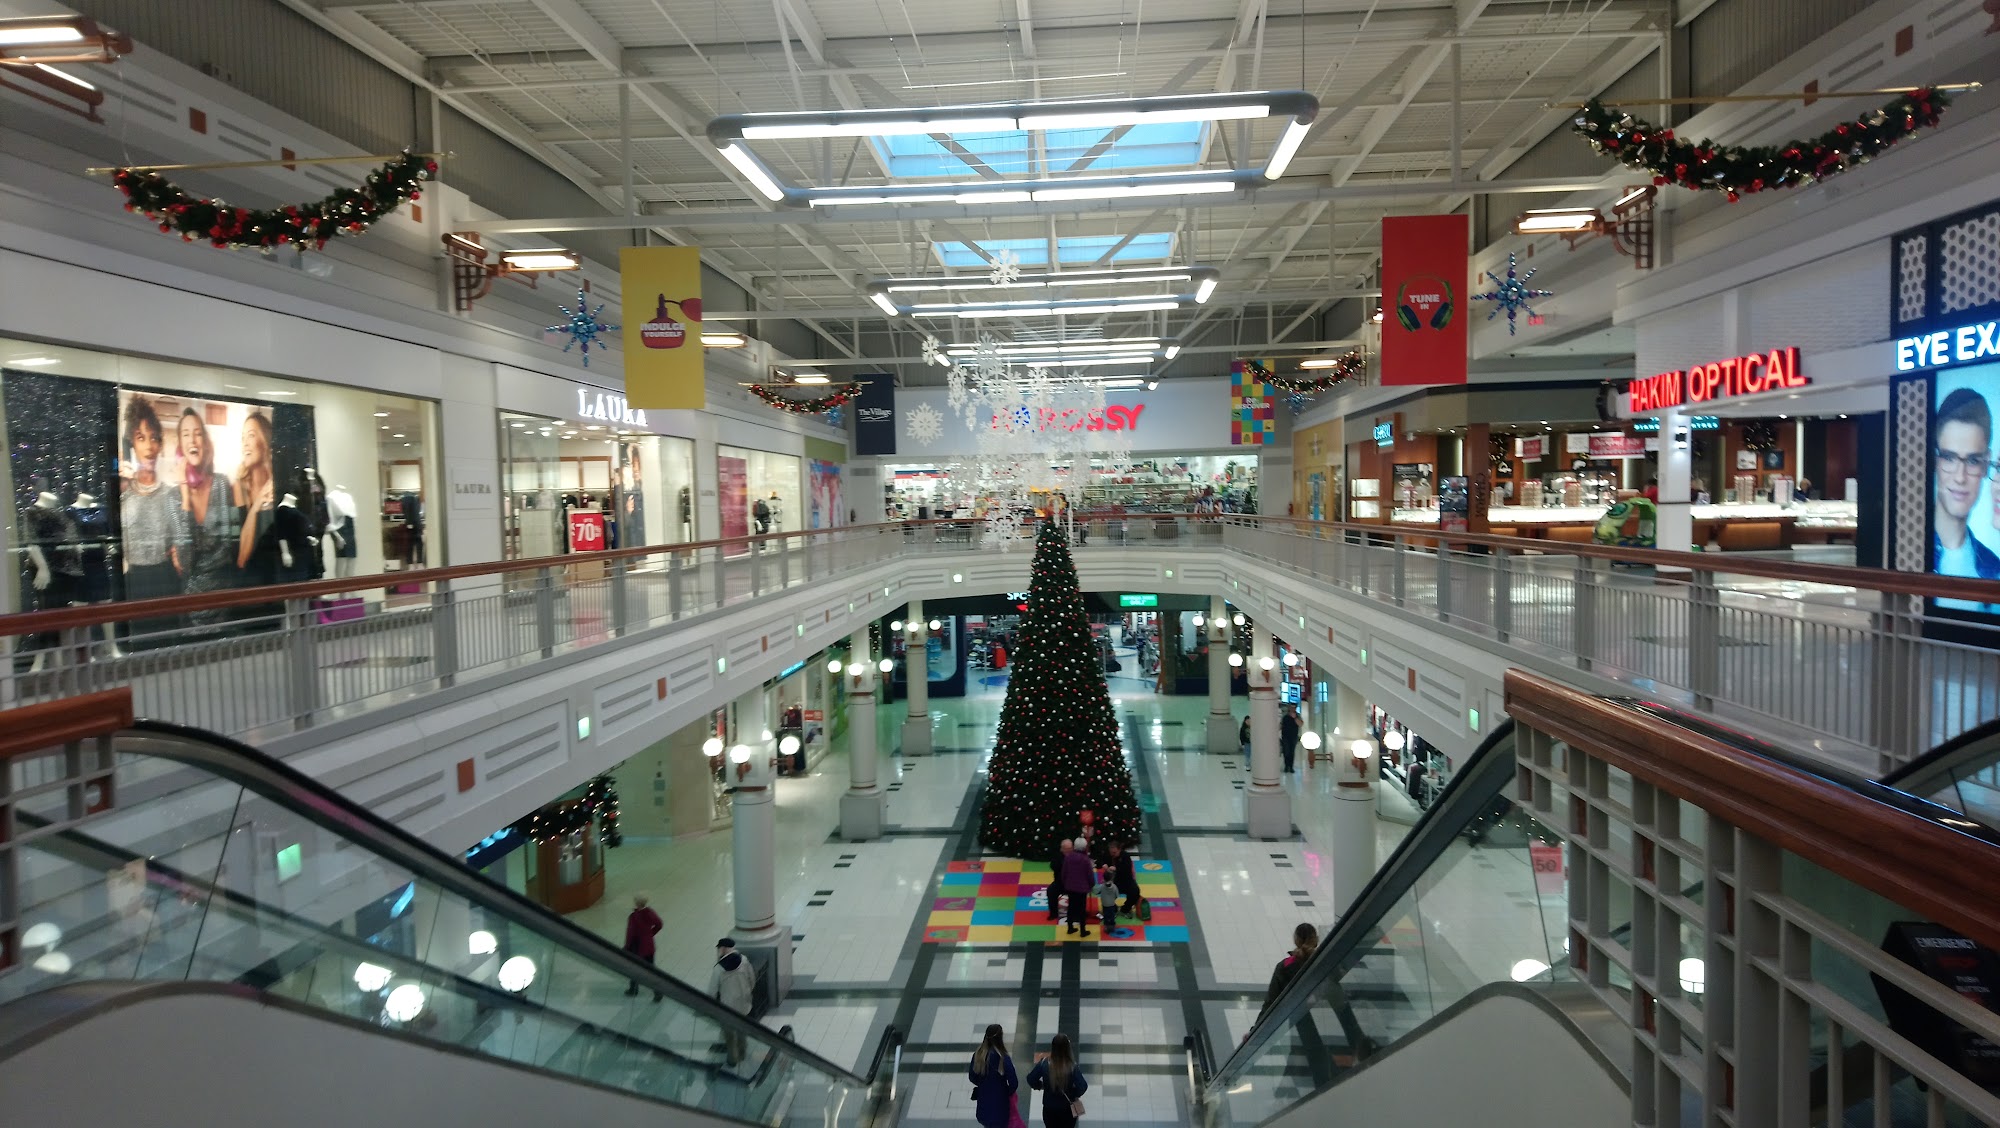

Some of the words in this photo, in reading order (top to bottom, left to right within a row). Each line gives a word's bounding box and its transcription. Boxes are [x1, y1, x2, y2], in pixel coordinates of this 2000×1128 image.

[1409, 294, 1440, 303] TUNE
[640, 322, 686, 331] INDULGE
[1897, 331, 1950, 371] EYE
[1629, 370, 1682, 412] HAKIM
[1688, 347, 1807, 402] OPTICAL
[858, 408, 871, 416] The
[869, 408, 891, 418] Village
[455, 483, 491, 494] LAURA
[1915, 937, 1977, 949] EMERGENCY
